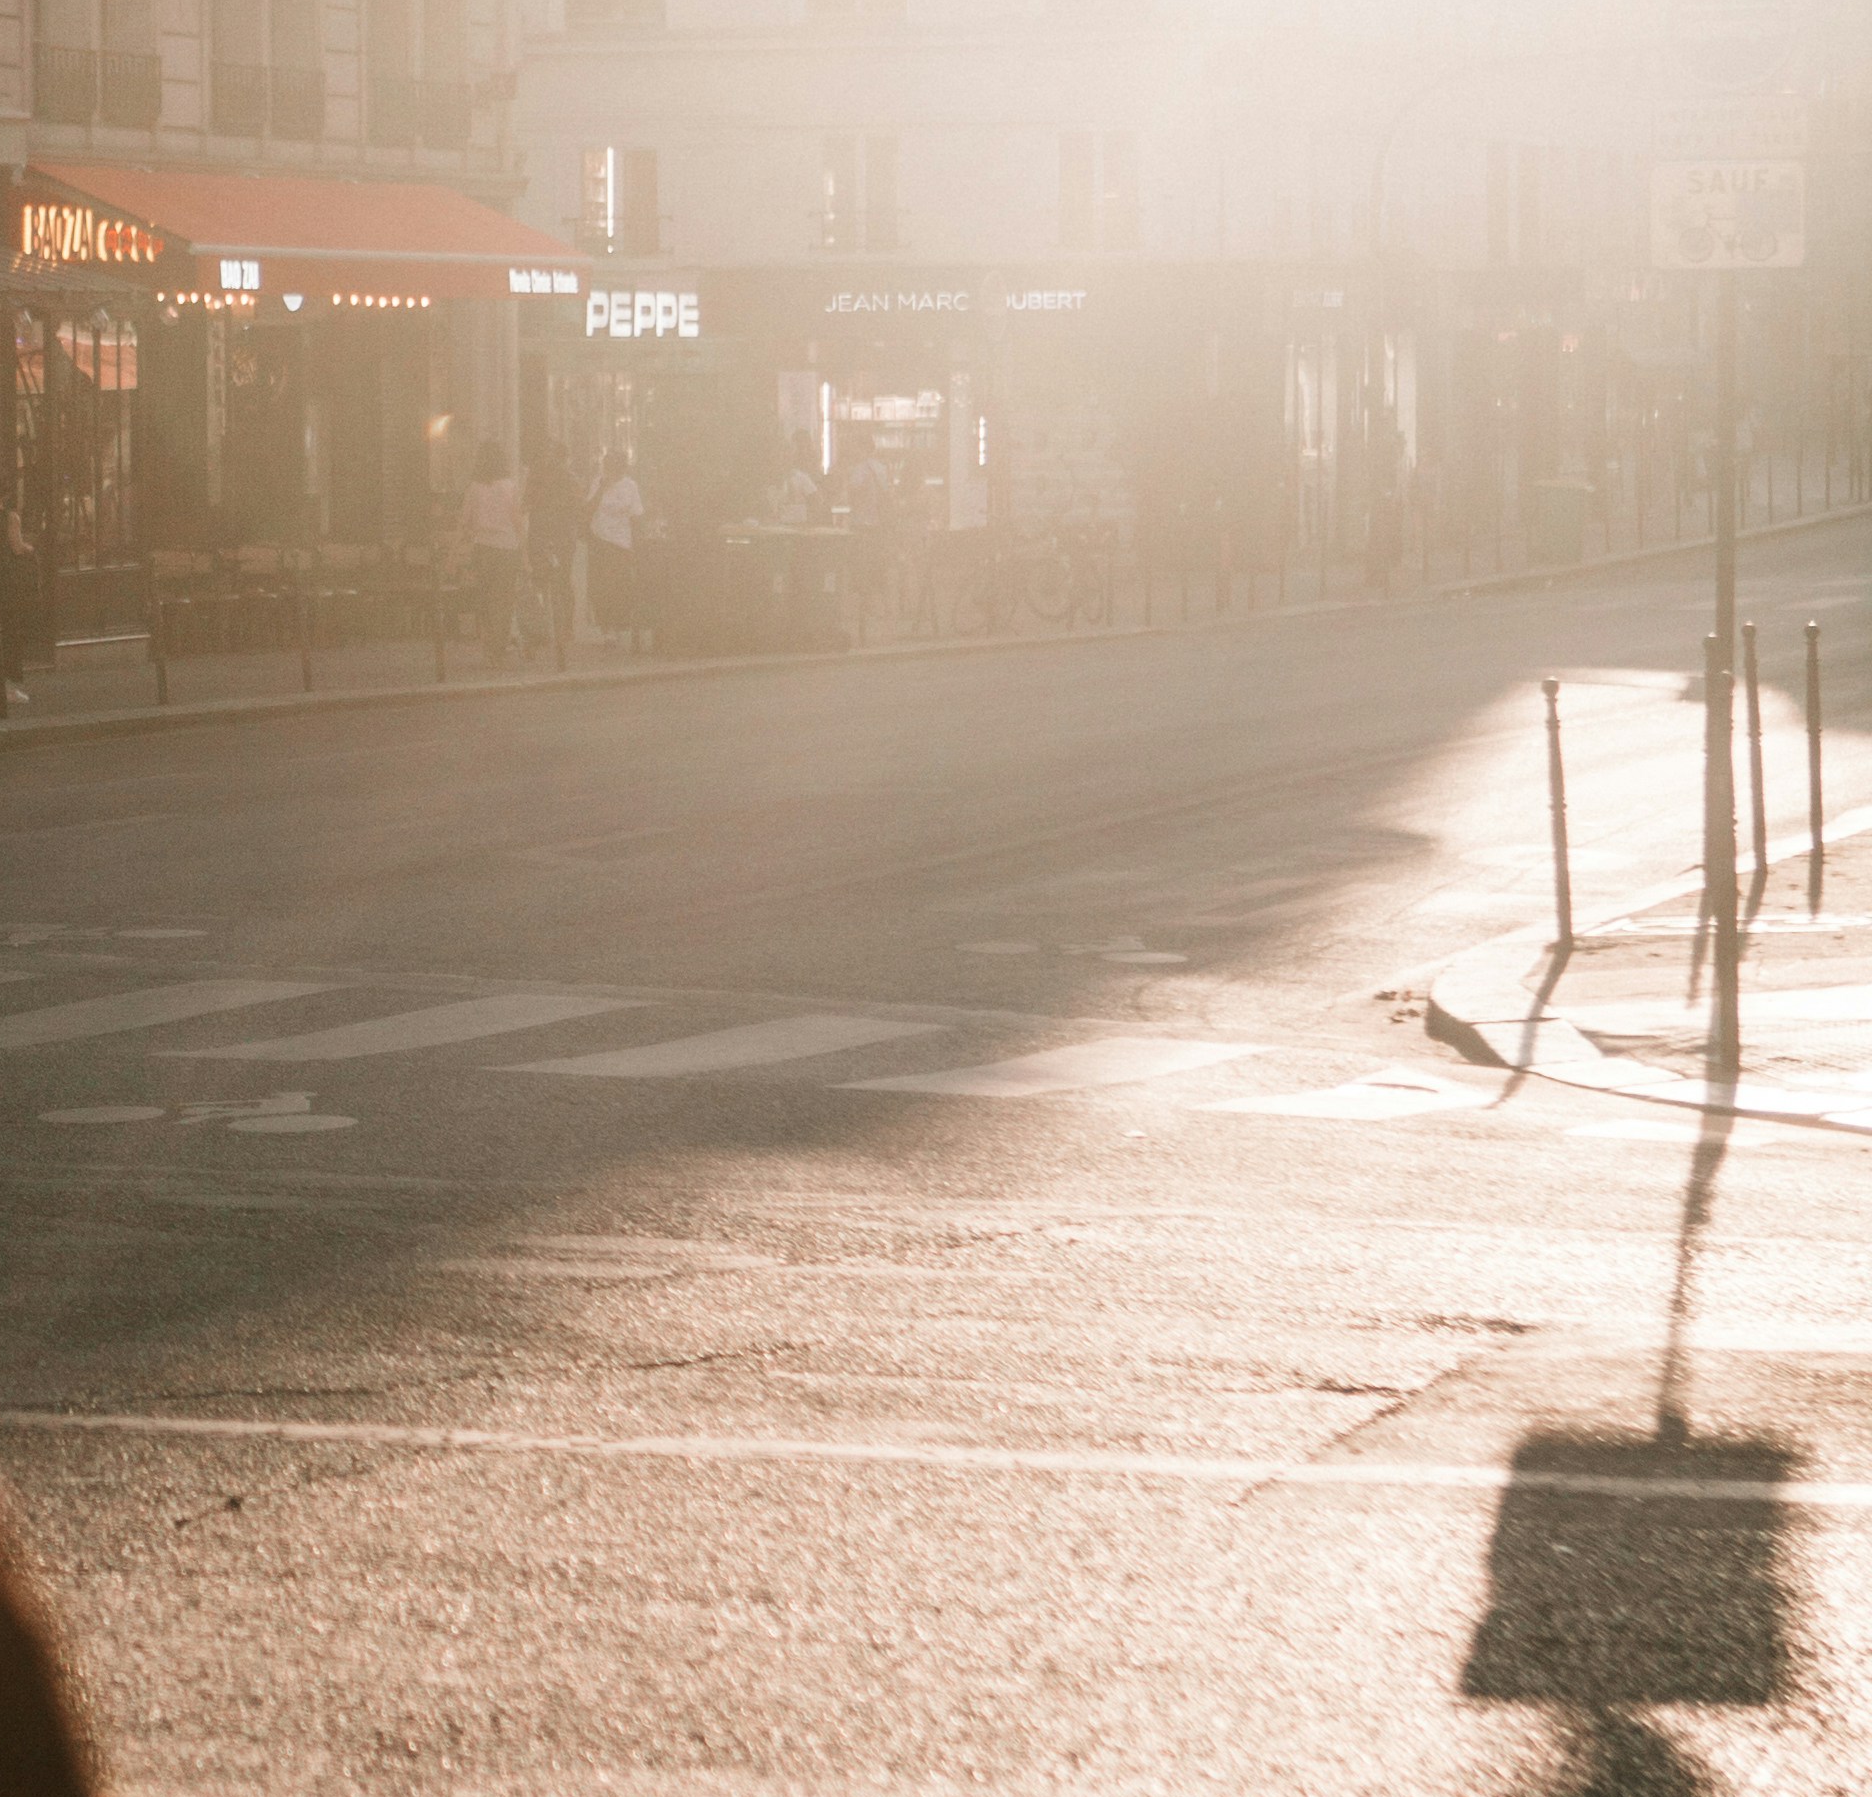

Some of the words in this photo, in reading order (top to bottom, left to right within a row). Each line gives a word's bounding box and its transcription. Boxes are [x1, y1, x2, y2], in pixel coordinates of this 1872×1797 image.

[1687, 168, 1769, 194] SAUF
[586, 290, 699, 338] PEPPE
[825, 292, 889, 313] JEAN
[898, 291, 969, 312] MARC
[1006, 289, 1087, 310] UBERT
